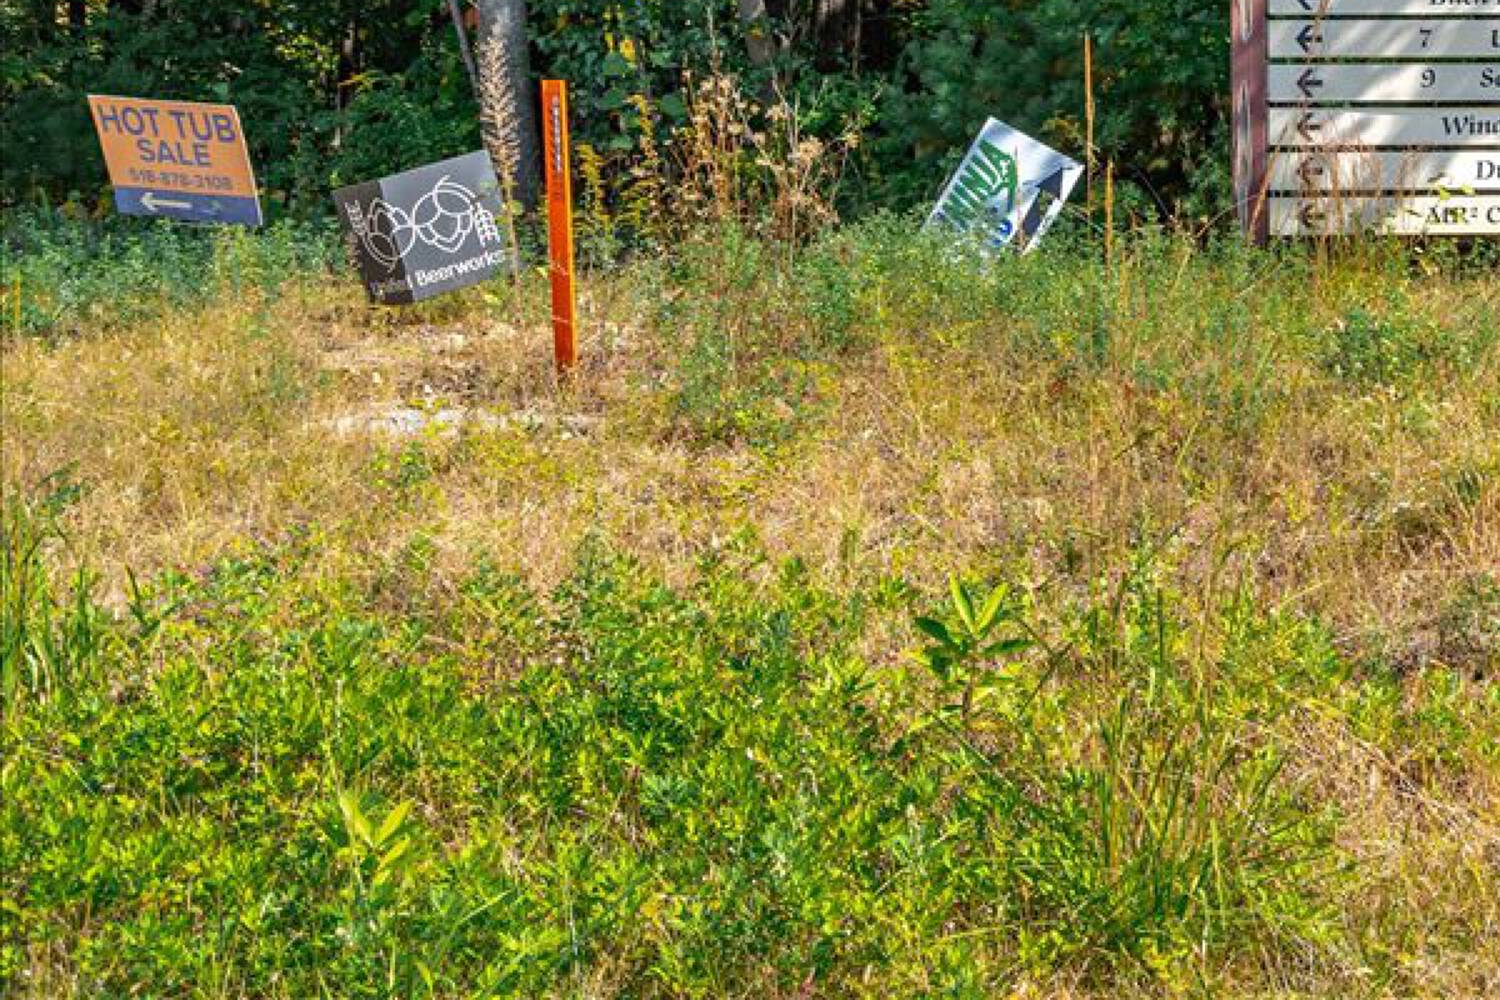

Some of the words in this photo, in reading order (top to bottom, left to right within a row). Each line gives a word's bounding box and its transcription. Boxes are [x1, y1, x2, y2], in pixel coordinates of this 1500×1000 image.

[1418, 28, 1432, 48] 7
[1420, 69, 1437, 88] 9
[98, 104, 159, 135] HOT
[168, 110, 236, 143] TUB
[138, 138, 211, 167] SALE
